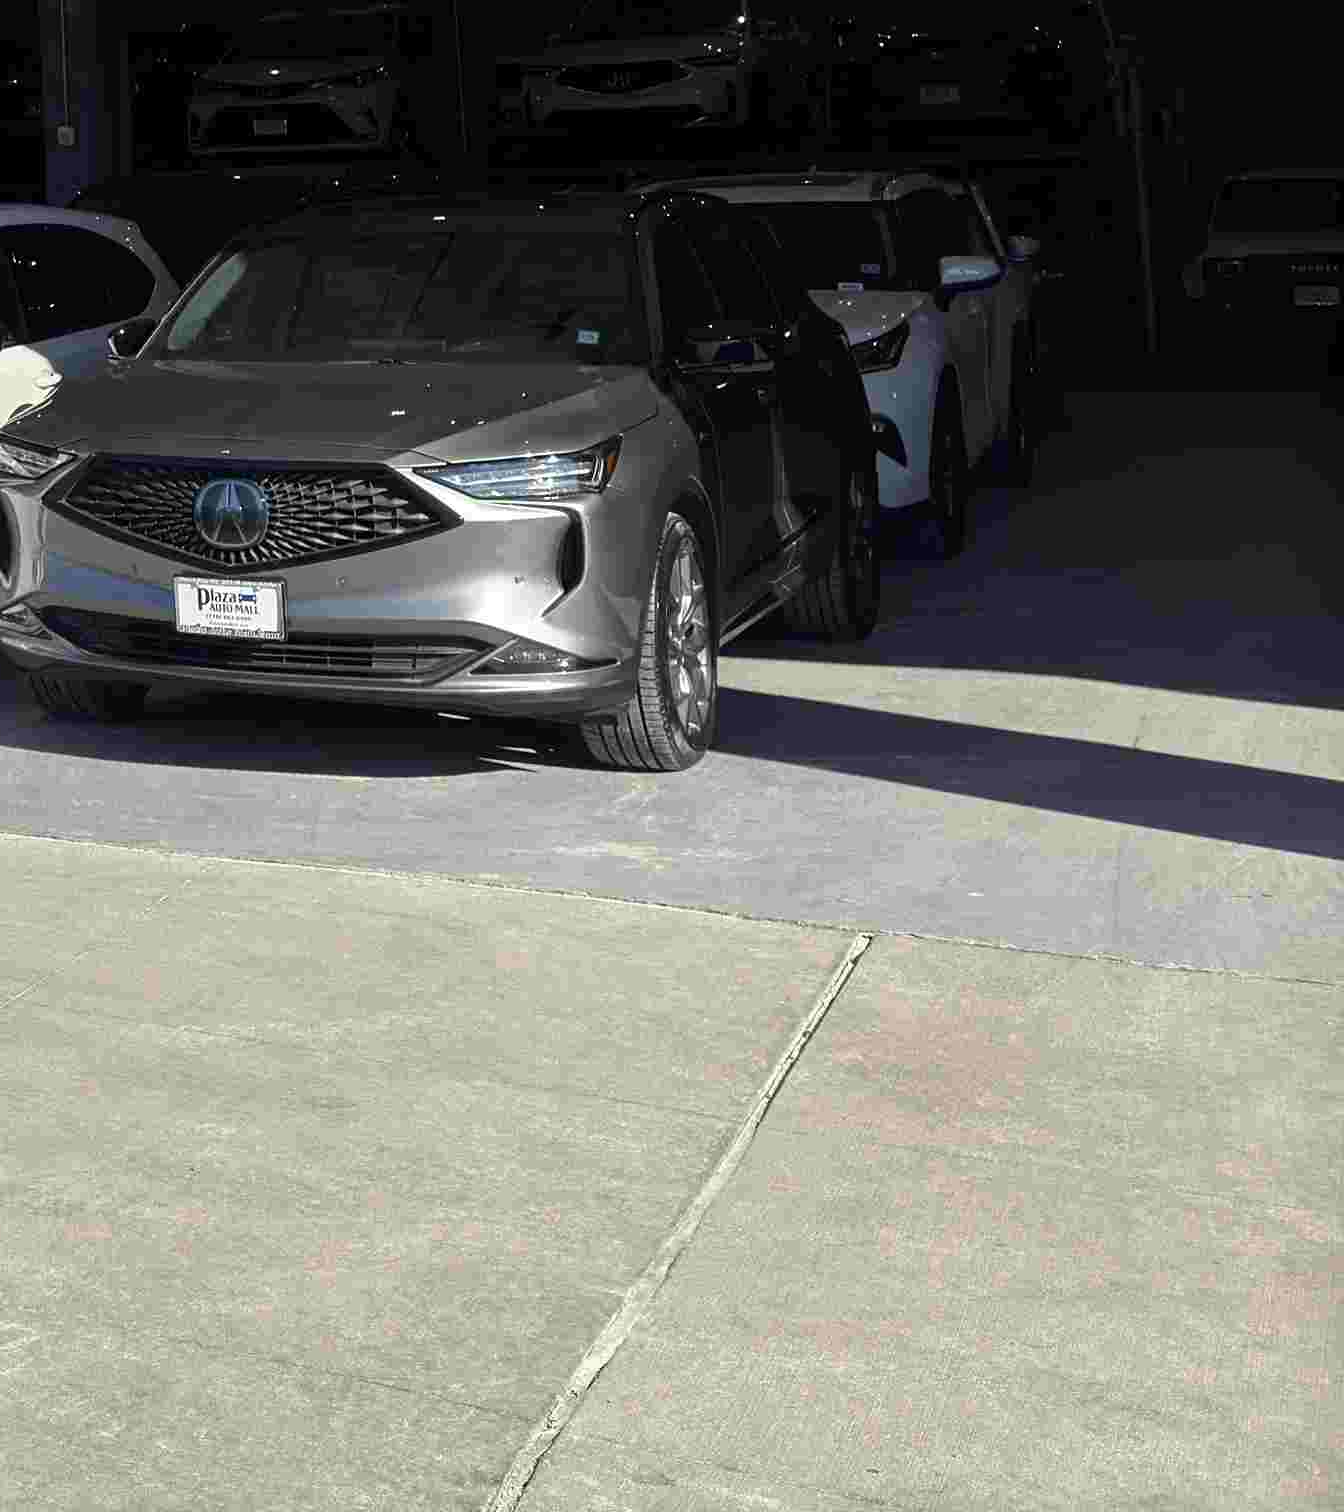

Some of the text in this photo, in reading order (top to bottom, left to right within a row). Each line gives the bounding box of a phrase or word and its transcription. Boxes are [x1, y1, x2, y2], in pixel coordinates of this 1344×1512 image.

[197, 587, 237, 610] Plaza
[210, 603, 259, 615] AUTO MALL
